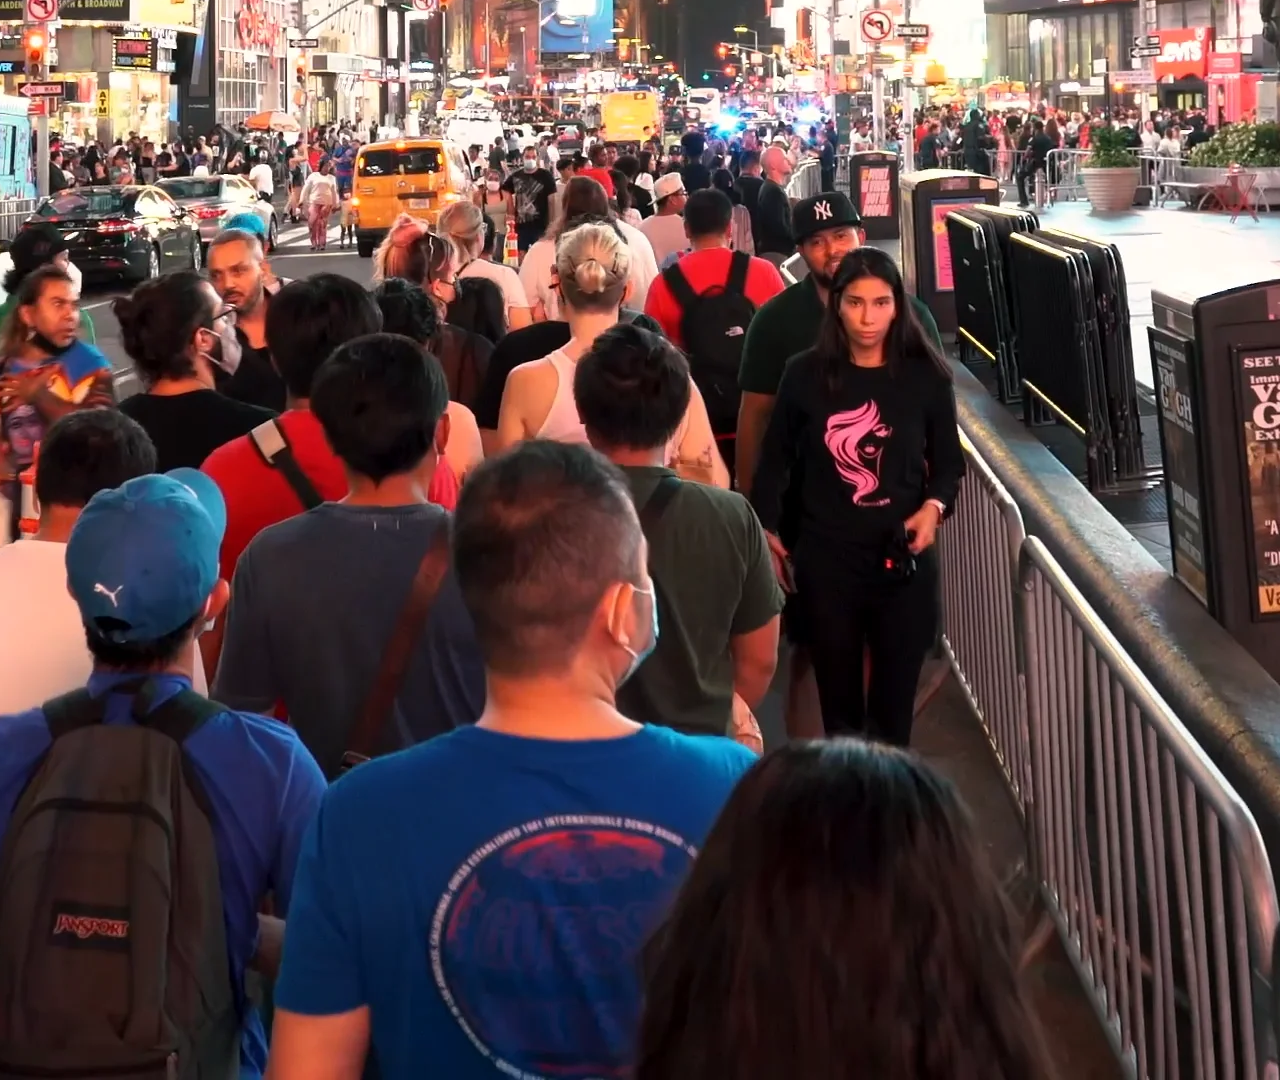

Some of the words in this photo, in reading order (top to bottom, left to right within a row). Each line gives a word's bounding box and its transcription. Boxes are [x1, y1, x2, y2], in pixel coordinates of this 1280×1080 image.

[99, 91, 107, 115] ATM
[1244, 357, 1274, 369] SEE
[468, 826, 521, 868] ESTABLISHED
[53, 913, 129, 938] JANSPORT
